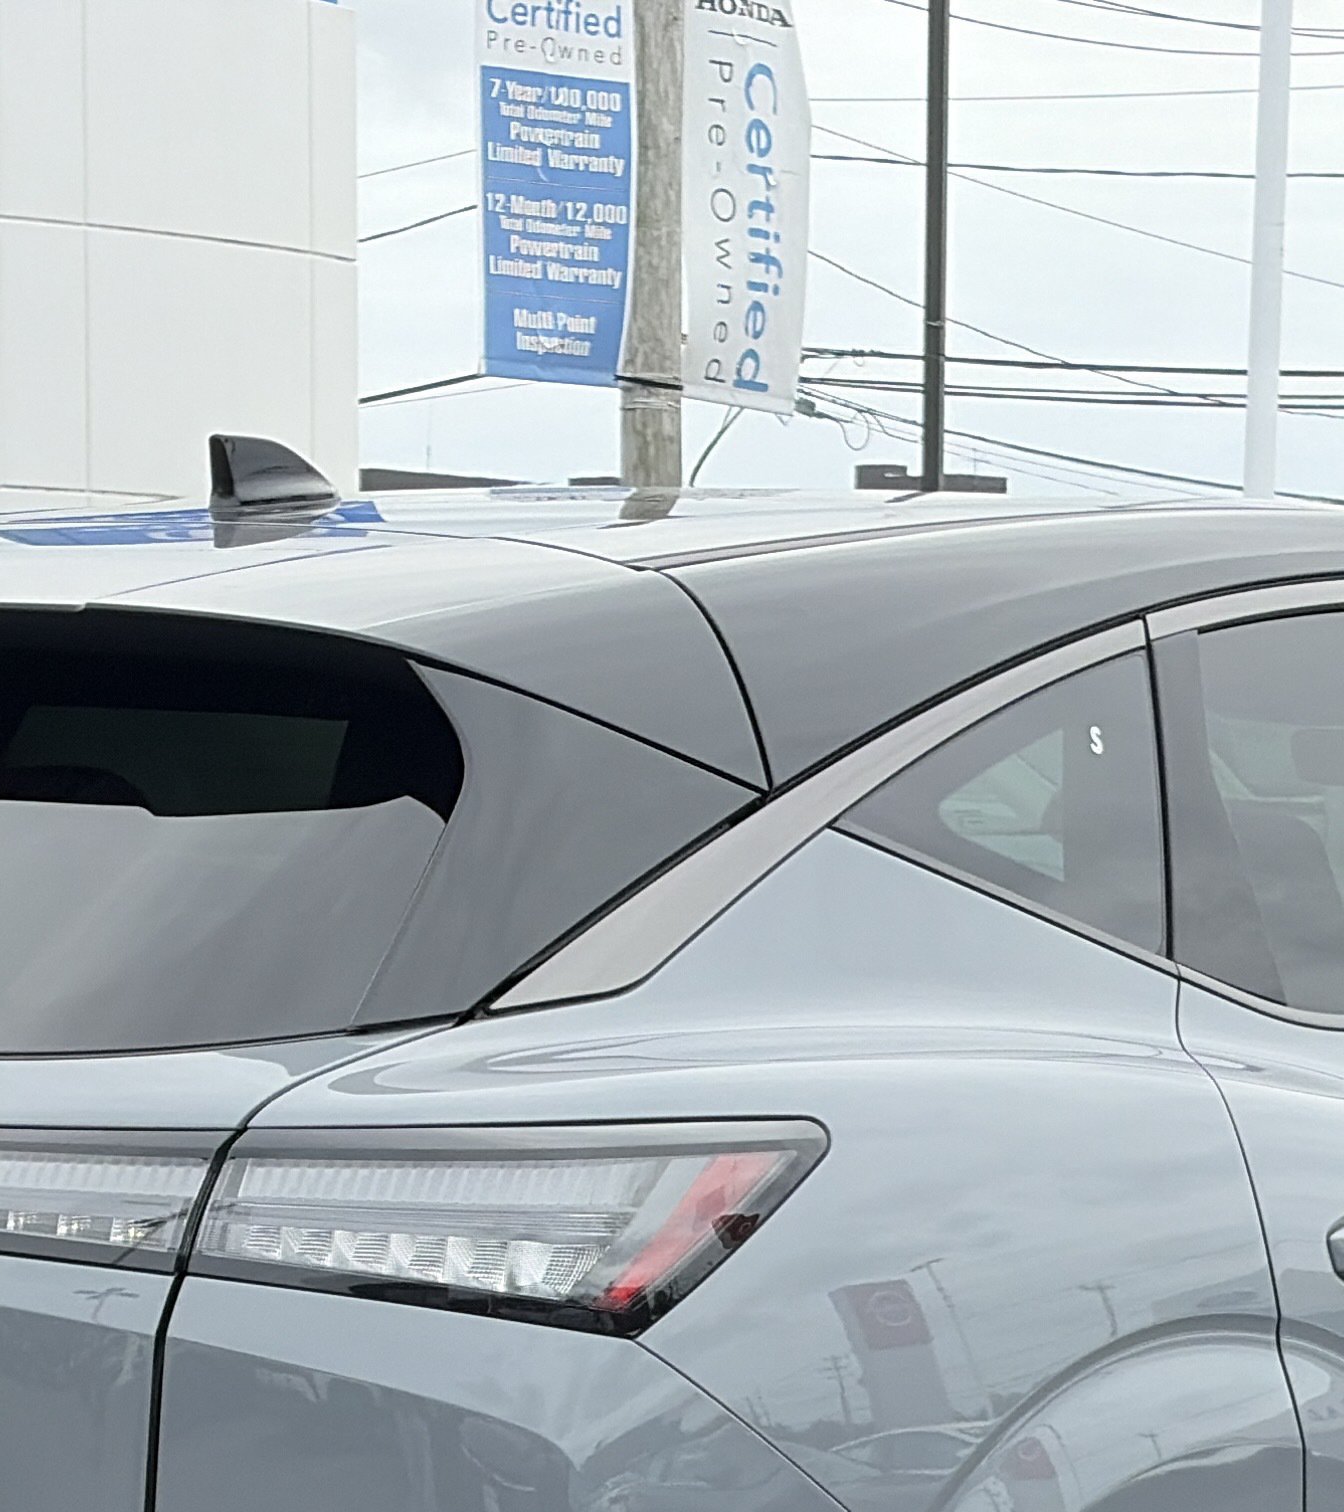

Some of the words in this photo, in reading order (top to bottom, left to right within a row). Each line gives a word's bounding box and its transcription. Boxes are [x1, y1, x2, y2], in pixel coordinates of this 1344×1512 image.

[486, 0, 622, 39] Certified
[487, 30, 622, 66] Pre-Owned
[510, 121, 601, 149] Powertrain
[487, 141, 543, 167] Limited
[547, 148, 625, 177] Warranty
[703, 58, 736, 384] Pre-Owned
[733, 62, 784, 393] Certified
[510, 235, 600, 262] Powertrain
[488, 255, 543, 279] Limited
[546, 261, 623, 289] Warranty
